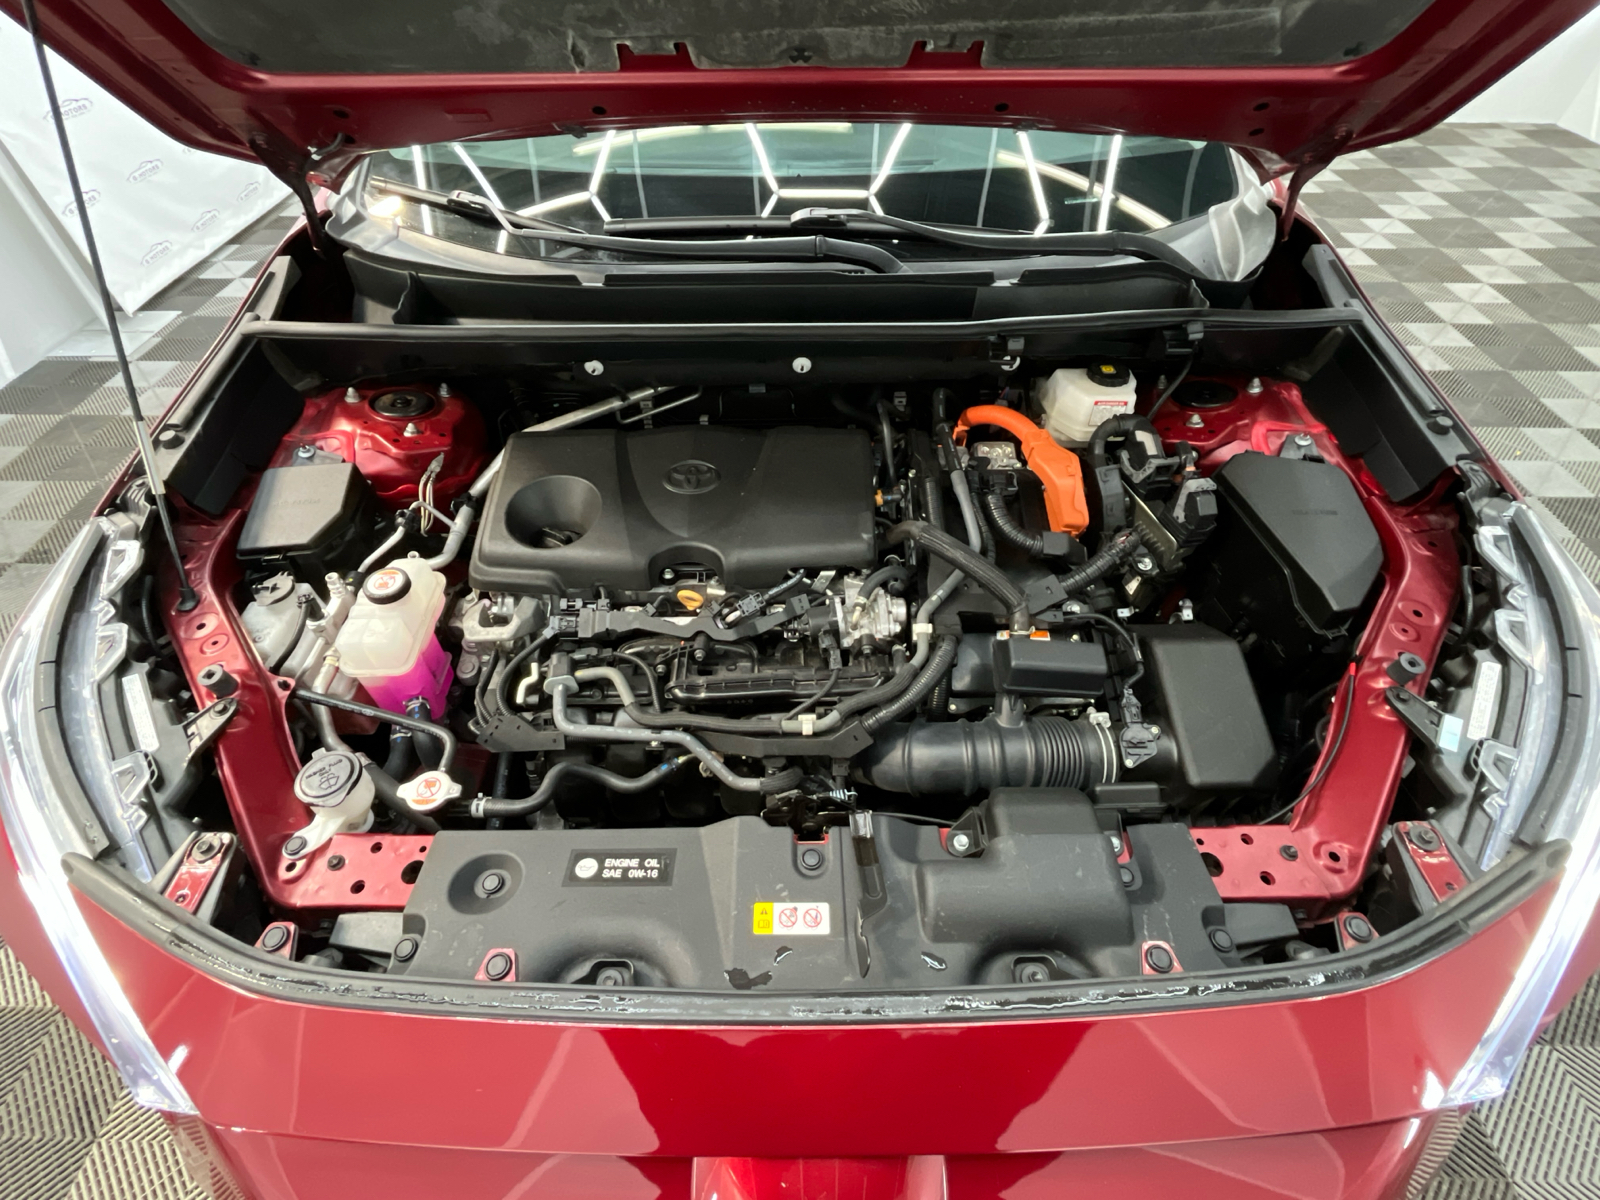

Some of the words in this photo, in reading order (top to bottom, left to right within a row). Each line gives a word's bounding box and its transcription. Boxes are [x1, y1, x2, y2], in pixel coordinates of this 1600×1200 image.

[604, 858, 640, 868] ENGINE
[644, 858, 660, 868] OIL
[601, 868, 623, 878] SAE
[627, 868, 659, 878] 0W-16
